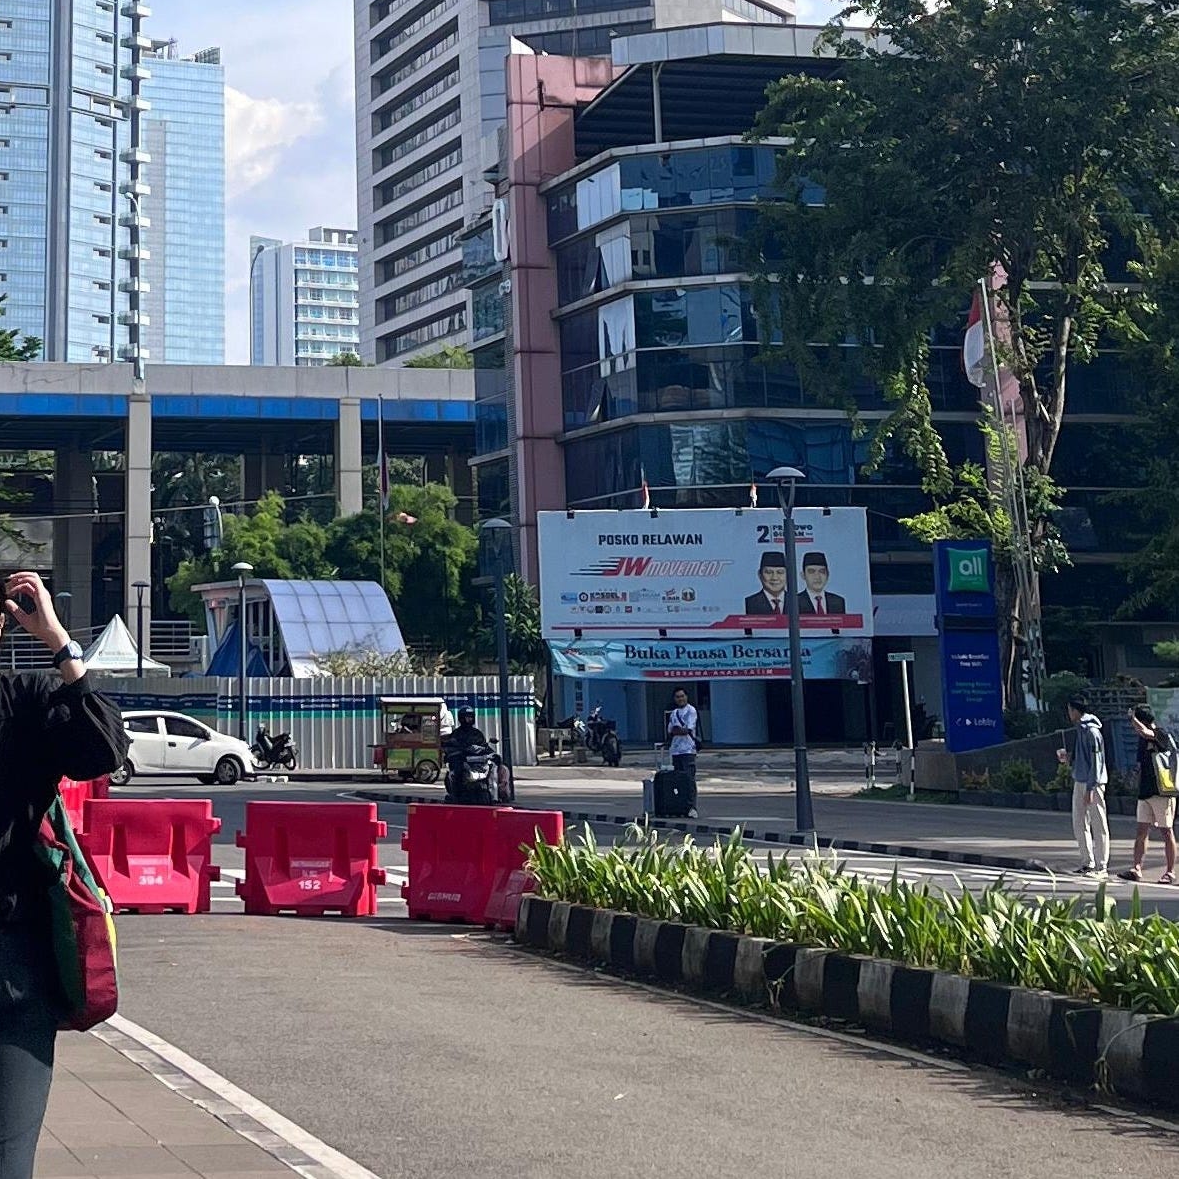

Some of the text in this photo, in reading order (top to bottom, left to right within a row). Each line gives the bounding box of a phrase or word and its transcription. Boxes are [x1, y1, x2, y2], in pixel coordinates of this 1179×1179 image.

[598, 533, 703, 546] POSKO RELAWAN
[757, 525, 770, 543] 2
[959, 556, 982, 575] all
[624, 644, 671, 660] Buka
[674, 645, 727, 660] Puasa
[298, 879, 321, 890] 152
